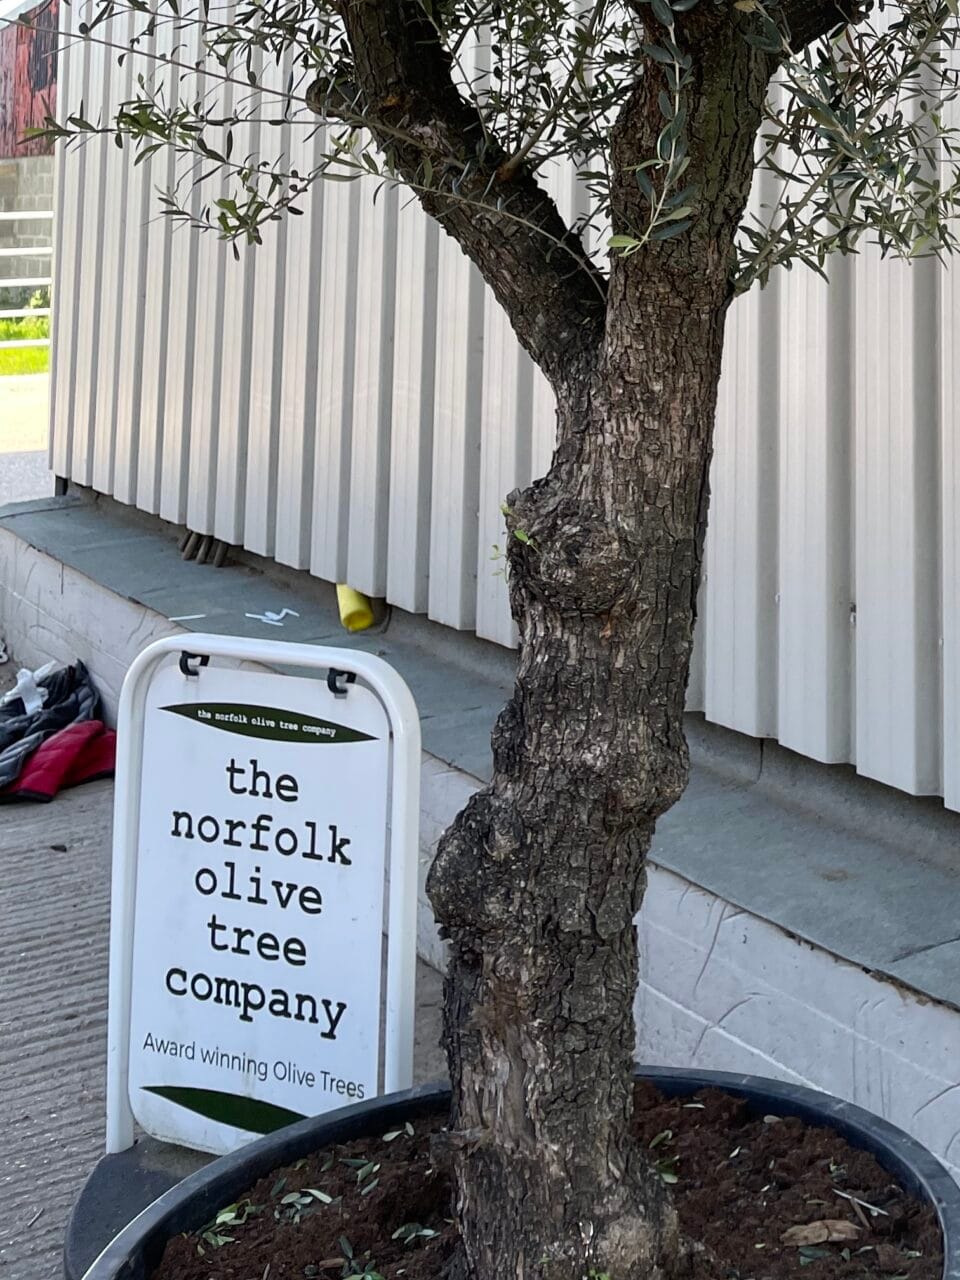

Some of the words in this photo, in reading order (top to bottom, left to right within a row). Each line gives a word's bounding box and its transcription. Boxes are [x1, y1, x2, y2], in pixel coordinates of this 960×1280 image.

[198, 709, 212, 719] the
[215, 712, 248, 724] norfolk
[251, 717, 276, 728] olive
[280, 720, 299, 731] tree
[302, 724, 337, 738] company
[226, 759, 299, 802] the
[171, 811, 352, 866] norfolk
[196, 862, 323, 915] olive
[207, 914, 307, 967] tree
[165, 967, 348, 1041] company
[143, 1032, 196, 1061] Award
[200, 1046, 268, 1082] winning
[273, 1060, 316, 1088] Olive
[320, 1070, 365, 1100] Trees
